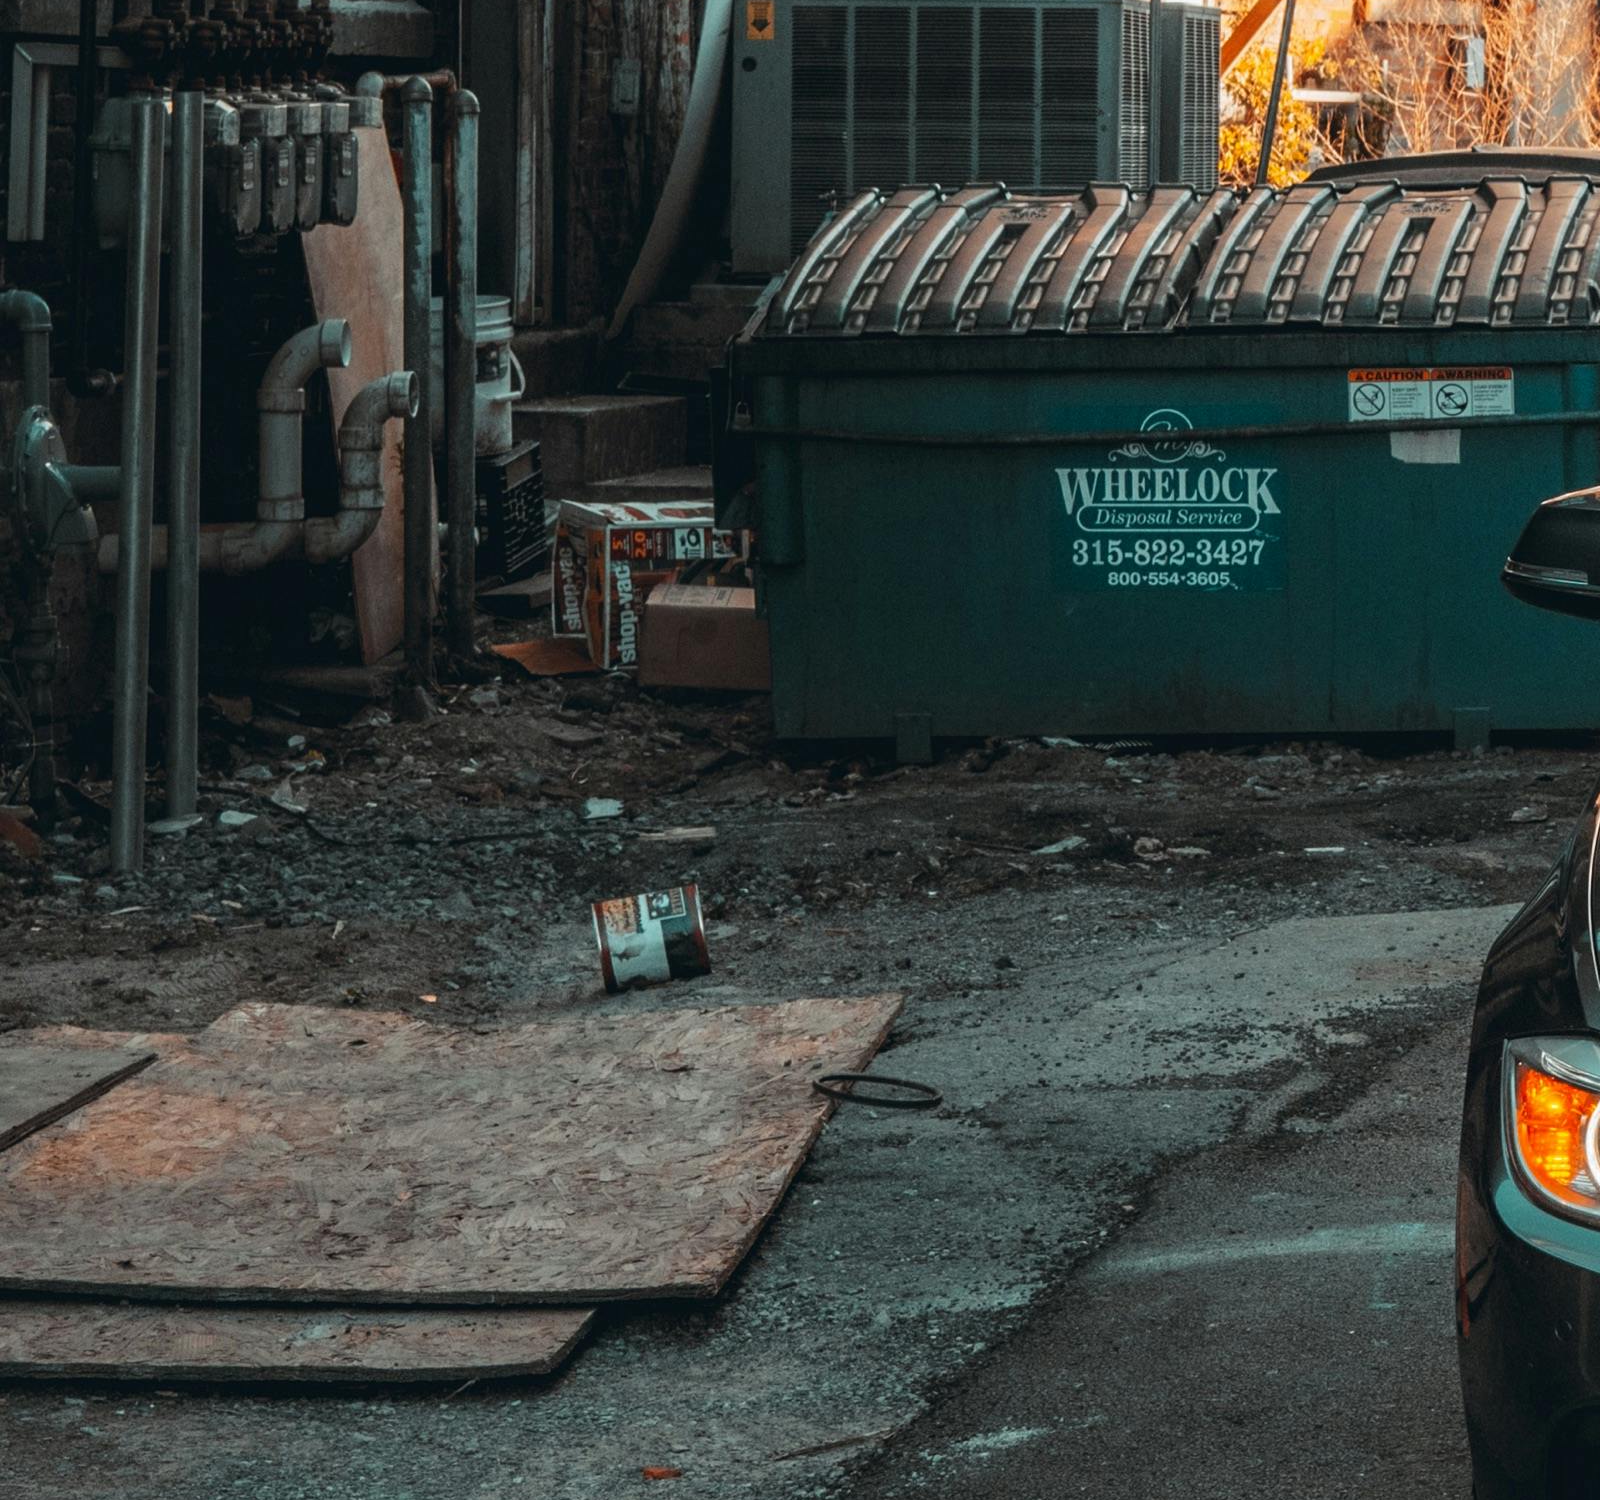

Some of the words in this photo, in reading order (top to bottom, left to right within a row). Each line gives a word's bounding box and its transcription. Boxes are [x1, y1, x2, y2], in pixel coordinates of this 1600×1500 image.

[1366, 370, 1424, 381] CAUTION
[1443, 368, 1507, 380] WARNING
[1054, 467, 1281, 516] WHEELOCK
[1095, 508, 1172, 528] Disposal
[1176, 508, 1242, 525] Service
[1072, 538, 1265, 567] 315-822-3427
